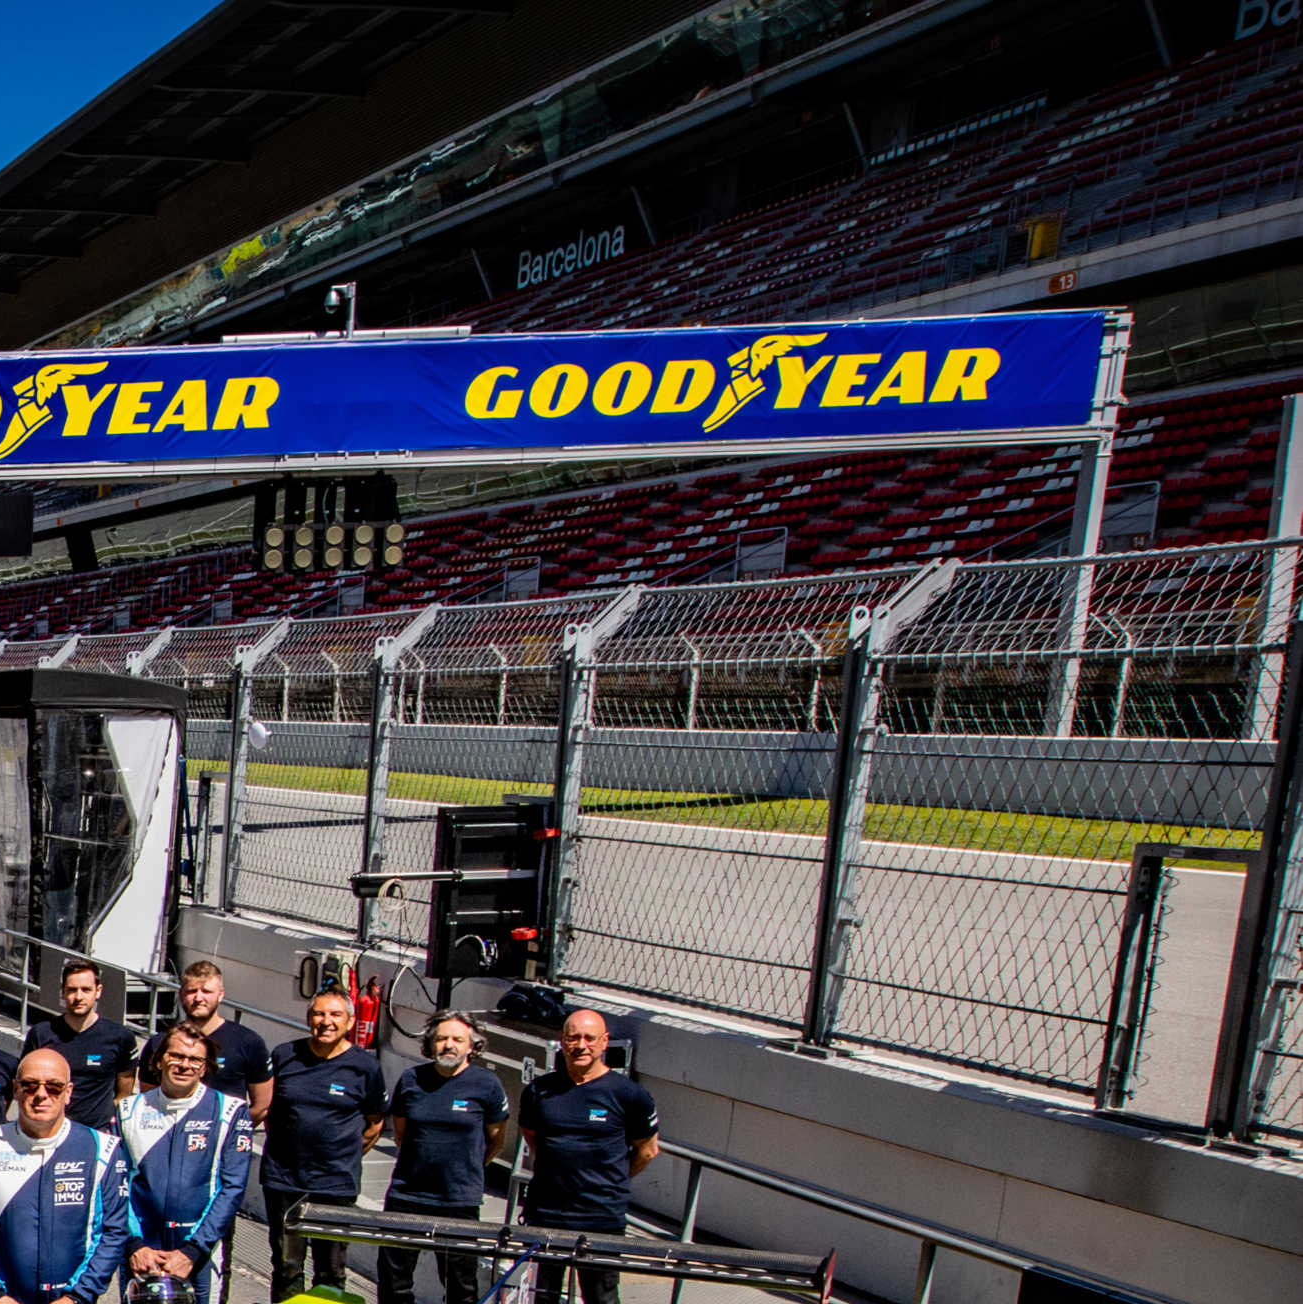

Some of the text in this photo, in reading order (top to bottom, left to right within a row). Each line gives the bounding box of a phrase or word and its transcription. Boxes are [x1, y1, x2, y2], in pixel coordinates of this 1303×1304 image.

[517, 225, 625, 290] Barcelona
[1059, 271, 1077, 290] 13
[464, 345, 1001, 420] GOODYEAR
[54, 1192, 85, 1204] IMMO
